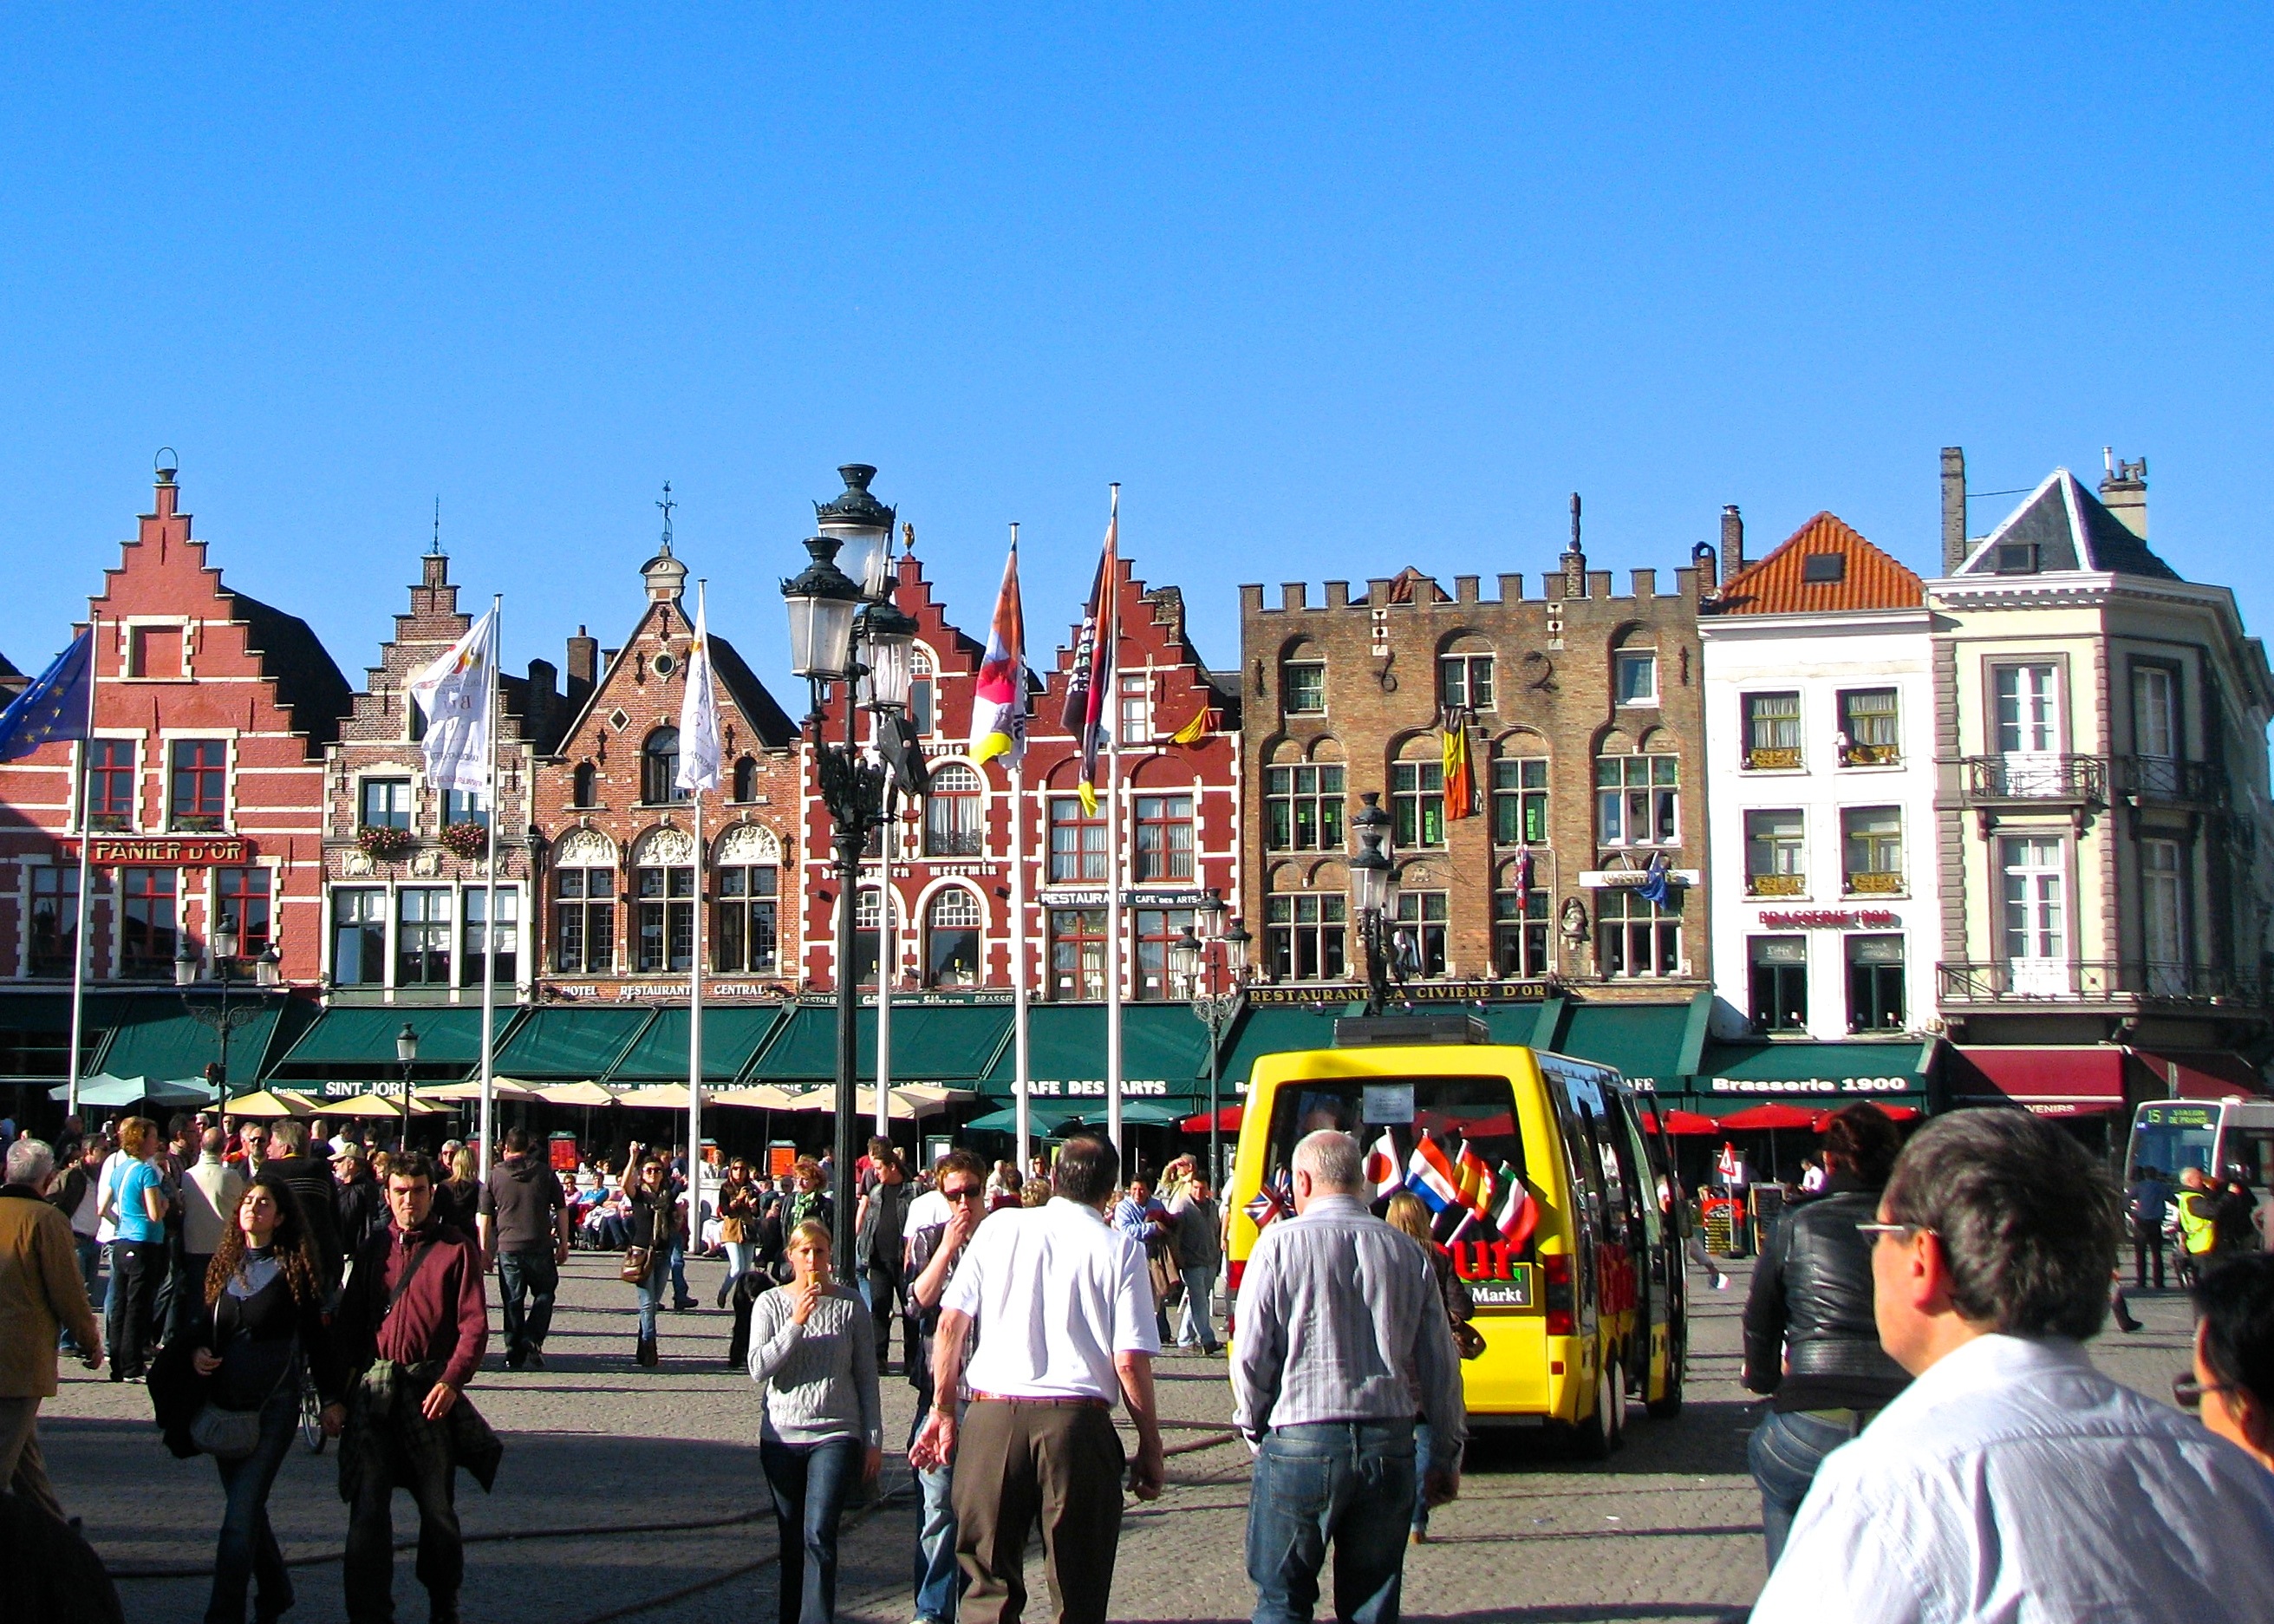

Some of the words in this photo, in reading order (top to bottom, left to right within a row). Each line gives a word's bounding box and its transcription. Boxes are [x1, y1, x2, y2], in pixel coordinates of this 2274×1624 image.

[95, 842, 181, 859] PANIER
[620, 985, 691, 996] RESTAURANT
[713, 984, 765, 995] CENTRAL
[1249, 988, 1370, 1001] RESTAURANT
[1503, 984, 1546, 996] D'OR
[1068, 1080, 1105, 1095] DES
[1711, 1077, 1835, 1092] Brasserie
[1841, 1076, 1907, 1091] 1900
[1471, 1287, 1522, 1302] Markt
